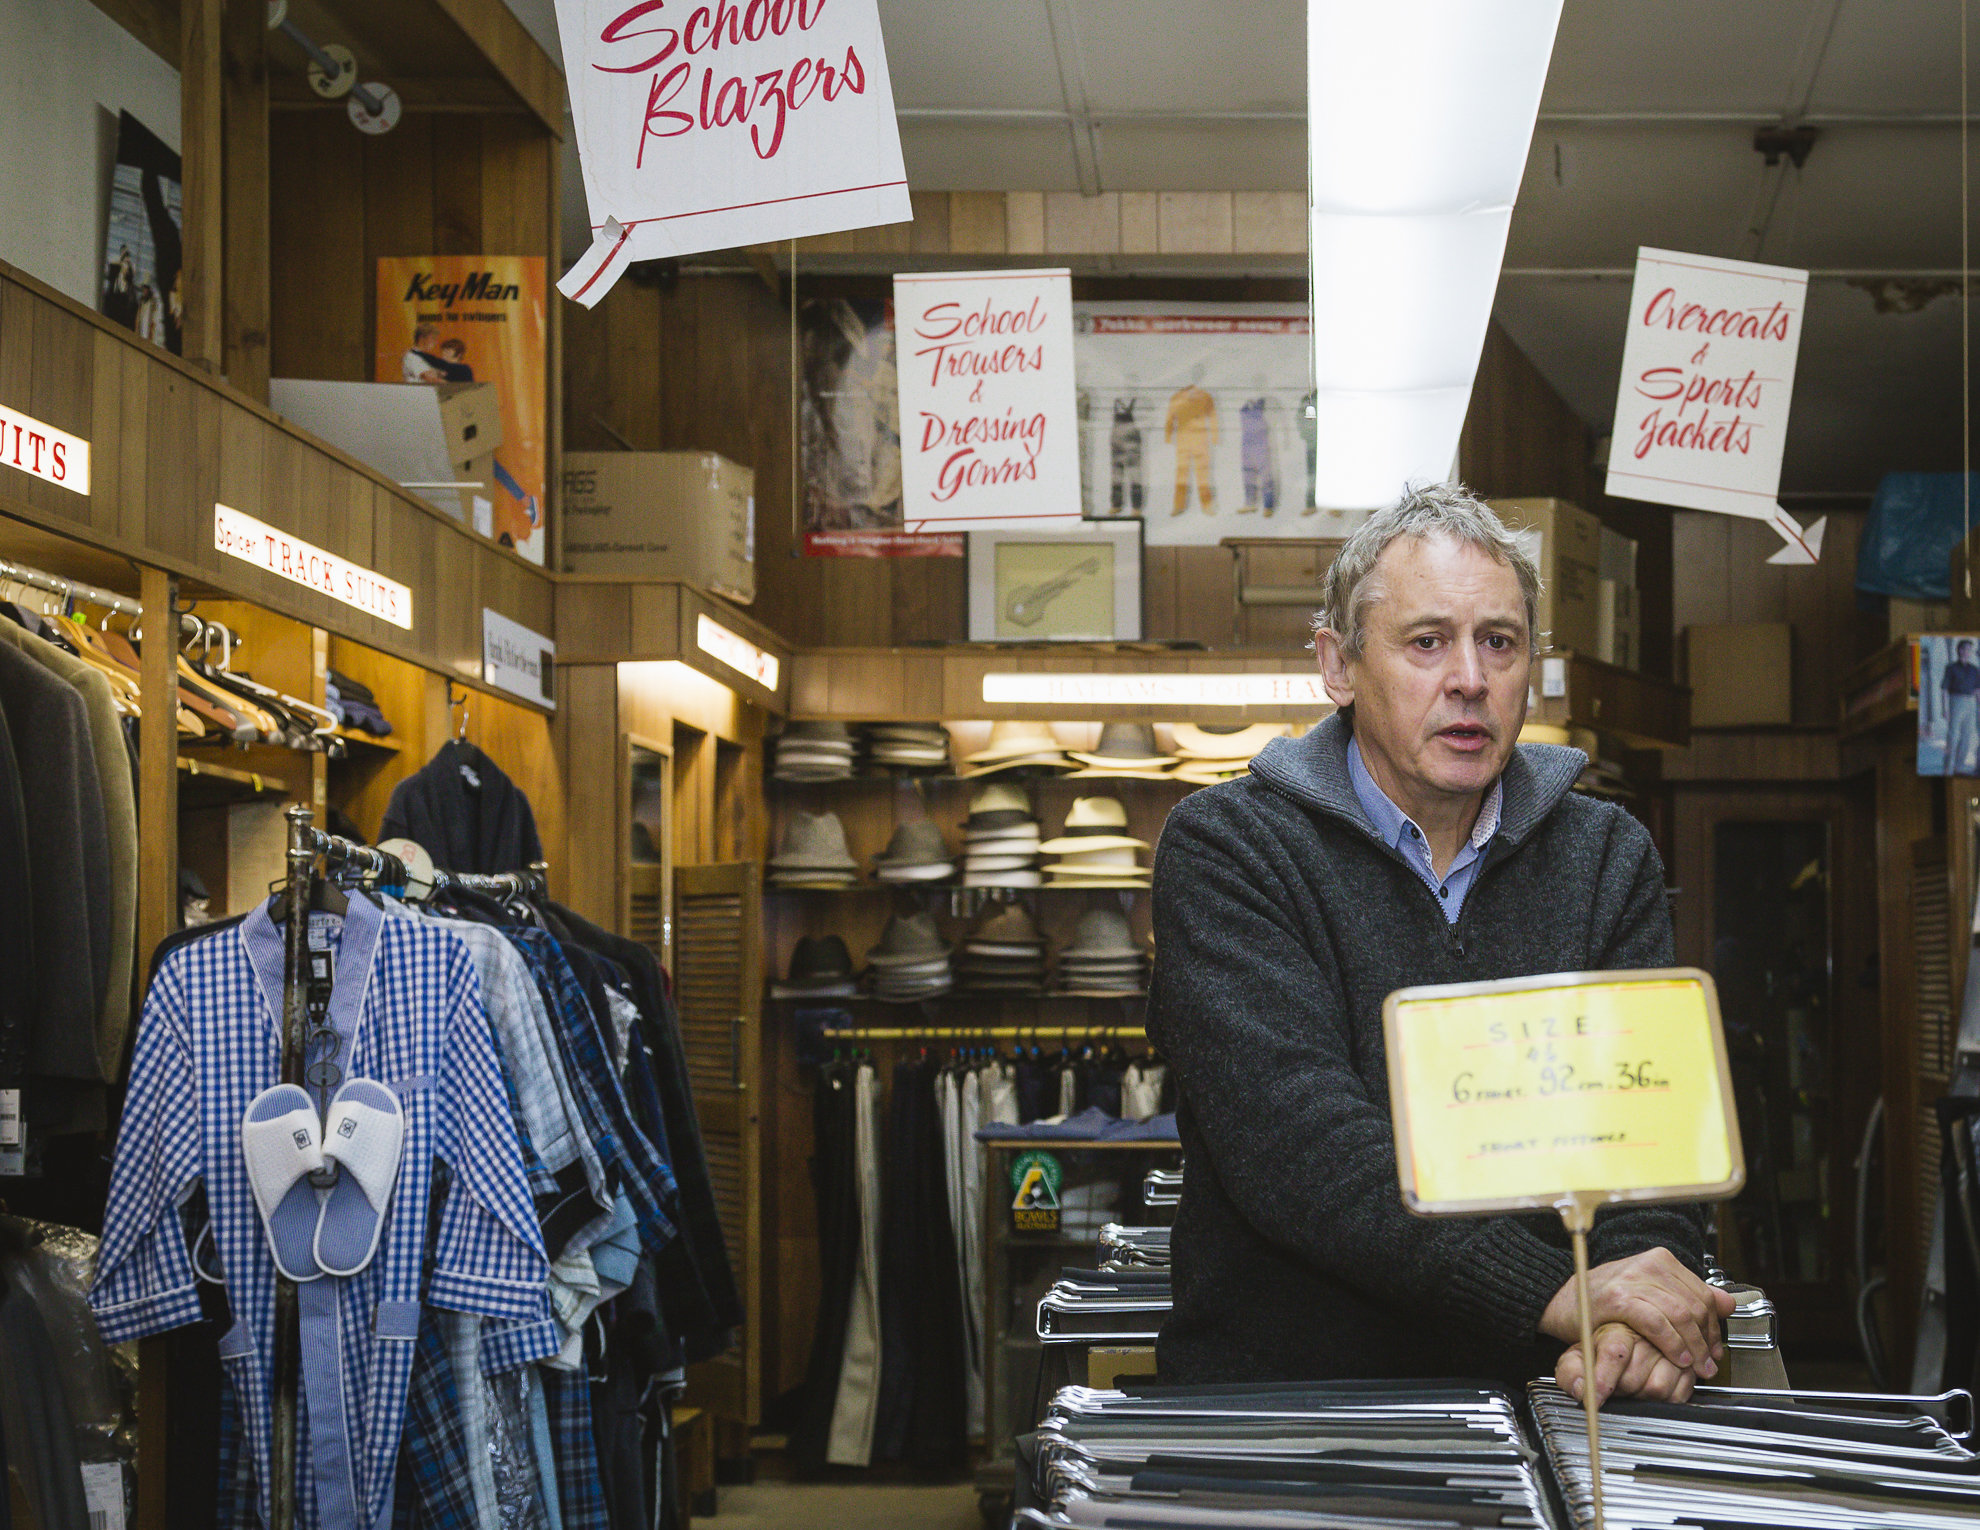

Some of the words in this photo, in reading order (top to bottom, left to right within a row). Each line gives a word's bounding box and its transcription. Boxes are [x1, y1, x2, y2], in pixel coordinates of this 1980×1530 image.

[636, 45, 866, 169] Blazers
[914, 296, 1047, 339] School
[1643, 287, 1796, 341] Overcoats
[914, 341, 1043, 387] Trousers
[1690, 342, 1709, 364] &
[968, 379, 984, 403] &
[1634, 367, 1782, 417] Sports
[920, 406, 1046, 457] Dressing
[1634, 408, 1765, 459] Jackets
[931, 447, 1037, 503] Gowns
[265, 535, 334, 592] TRACK
[345, 571, 398, 618] SUITS
[1488, 1015, 1591, 1042] SIZE
[1014, 1210, 1057, 1223] BOWLS
